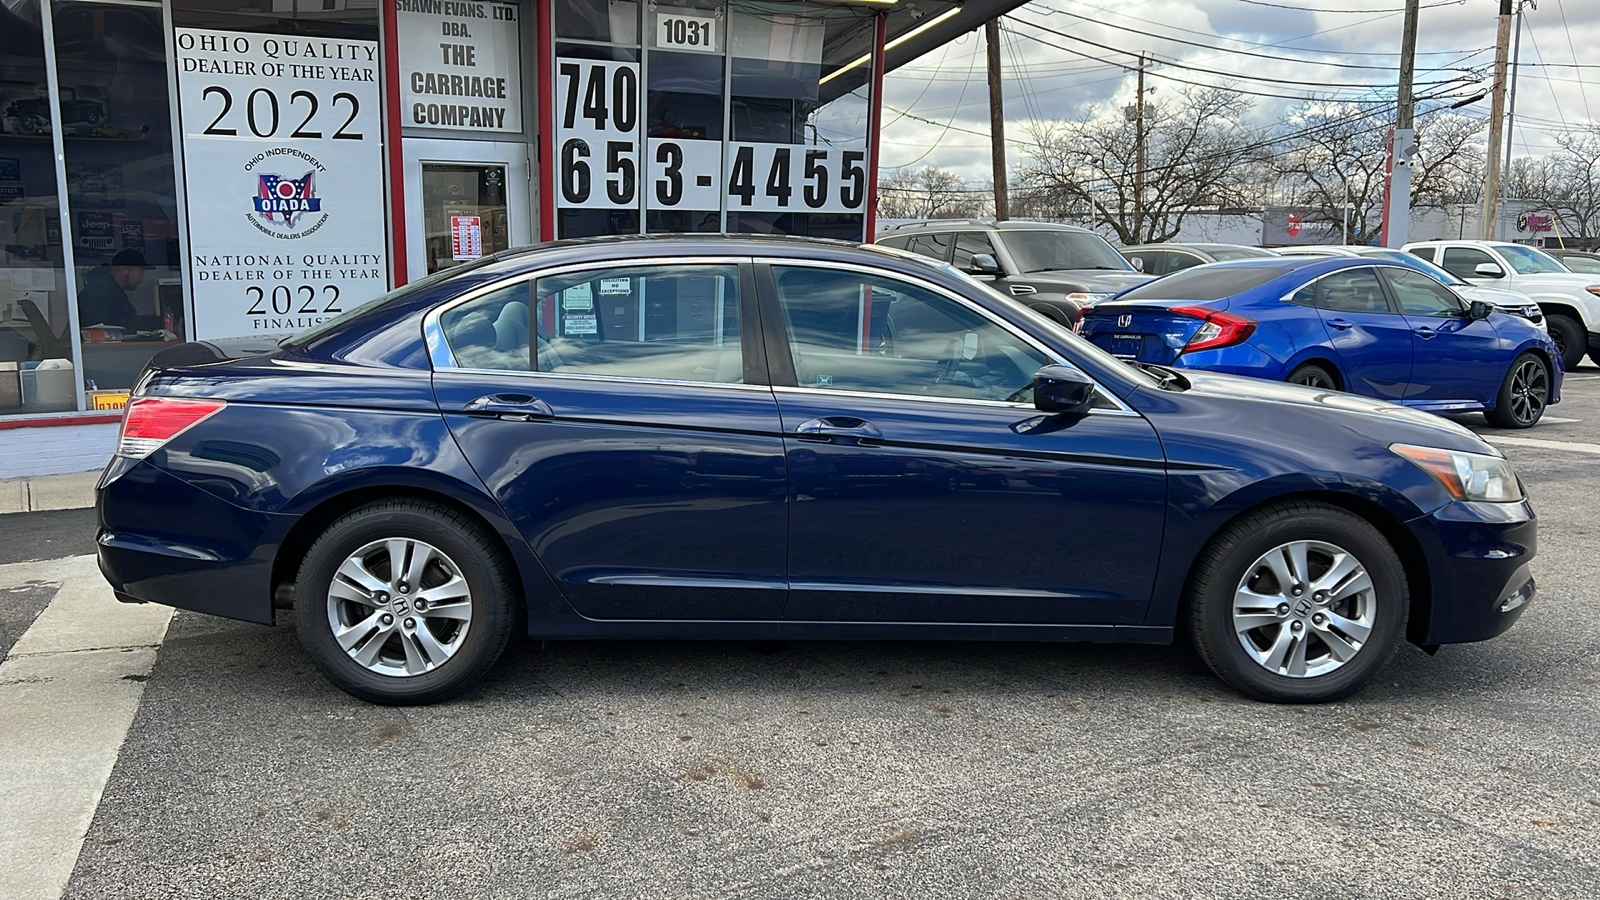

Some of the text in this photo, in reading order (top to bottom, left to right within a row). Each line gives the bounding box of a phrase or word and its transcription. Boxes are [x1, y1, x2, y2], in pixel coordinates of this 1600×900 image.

[395, 0, 517, 21] SHAWN EVANS. LTD.
[442, 21, 472, 38] DBA.
[663, 18, 710, 46] 1031
[178, 33, 376, 61] OHIO QUALITY
[440, 43, 476, 67] THE
[183, 57, 375, 82] DEALER OF THE YEAR
[410, 71, 506, 99] CARRIAGE
[559, 63, 637, 132] 740
[202, 85, 364, 141] 2022
[413, 102, 506, 128] COMPANY
[244, 147, 327, 173] OHIO INDEPENDENT
[261, 199, 310, 211] OIADA
[81, 218, 111, 230] Jeep
[245, 212, 329, 240] AUTOMOBILE DEALERS ASSOCIATION
[195, 254, 381, 267] NATIONAL QUALITY
[199, 269, 380, 281] DEALER OF THE YEAR
[245, 284, 342, 315] 2022
